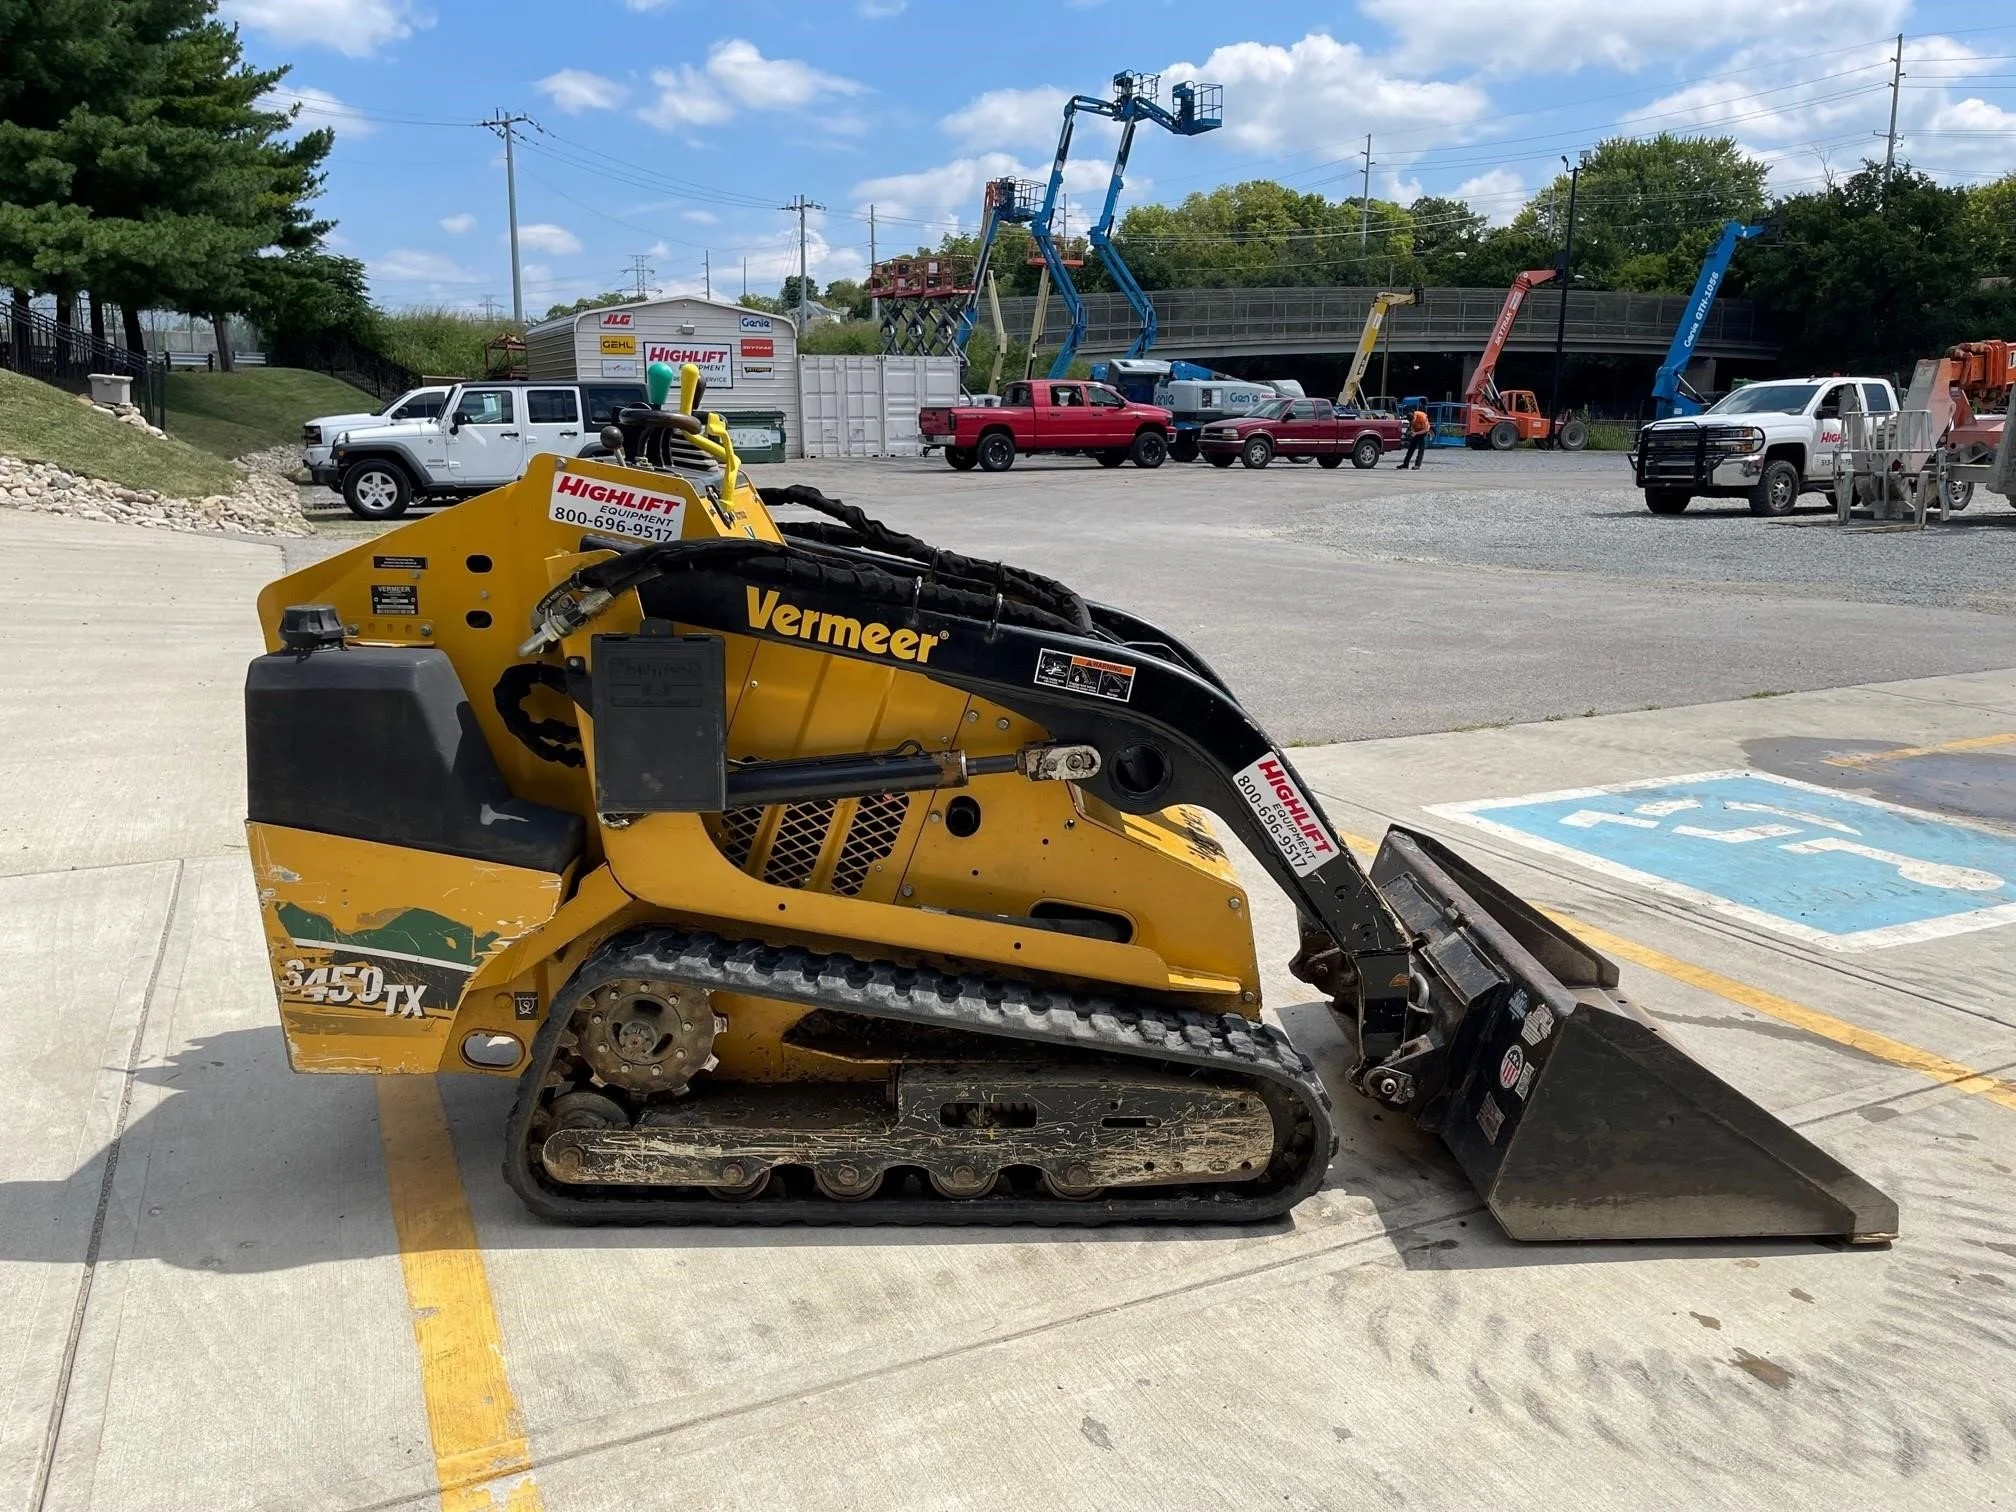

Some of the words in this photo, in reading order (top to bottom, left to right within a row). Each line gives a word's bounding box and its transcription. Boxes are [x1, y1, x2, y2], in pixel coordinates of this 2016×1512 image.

[1695, 271, 1719, 320] GTH-1056
[602, 313, 632, 325] JLG
[741, 317, 770, 328] Genie
[602, 341, 633, 349] GEHL
[649, 347, 728, 363] HIGHLIFT
[1230, 392, 1259, 402] Genie
[557, 476, 680, 515] HIGHLIFT
[555, 507, 672, 542] 800-696-9517
[600, 505, 674, 527] EQUIPMENT
[1092, 662, 1122, 673] WARNING
[1257, 759, 1333, 853] HIGHLIFT
[1238, 775, 1307, 867] 800-696-9517
[1273, 803, 1316, 860] EQUIPMENT
